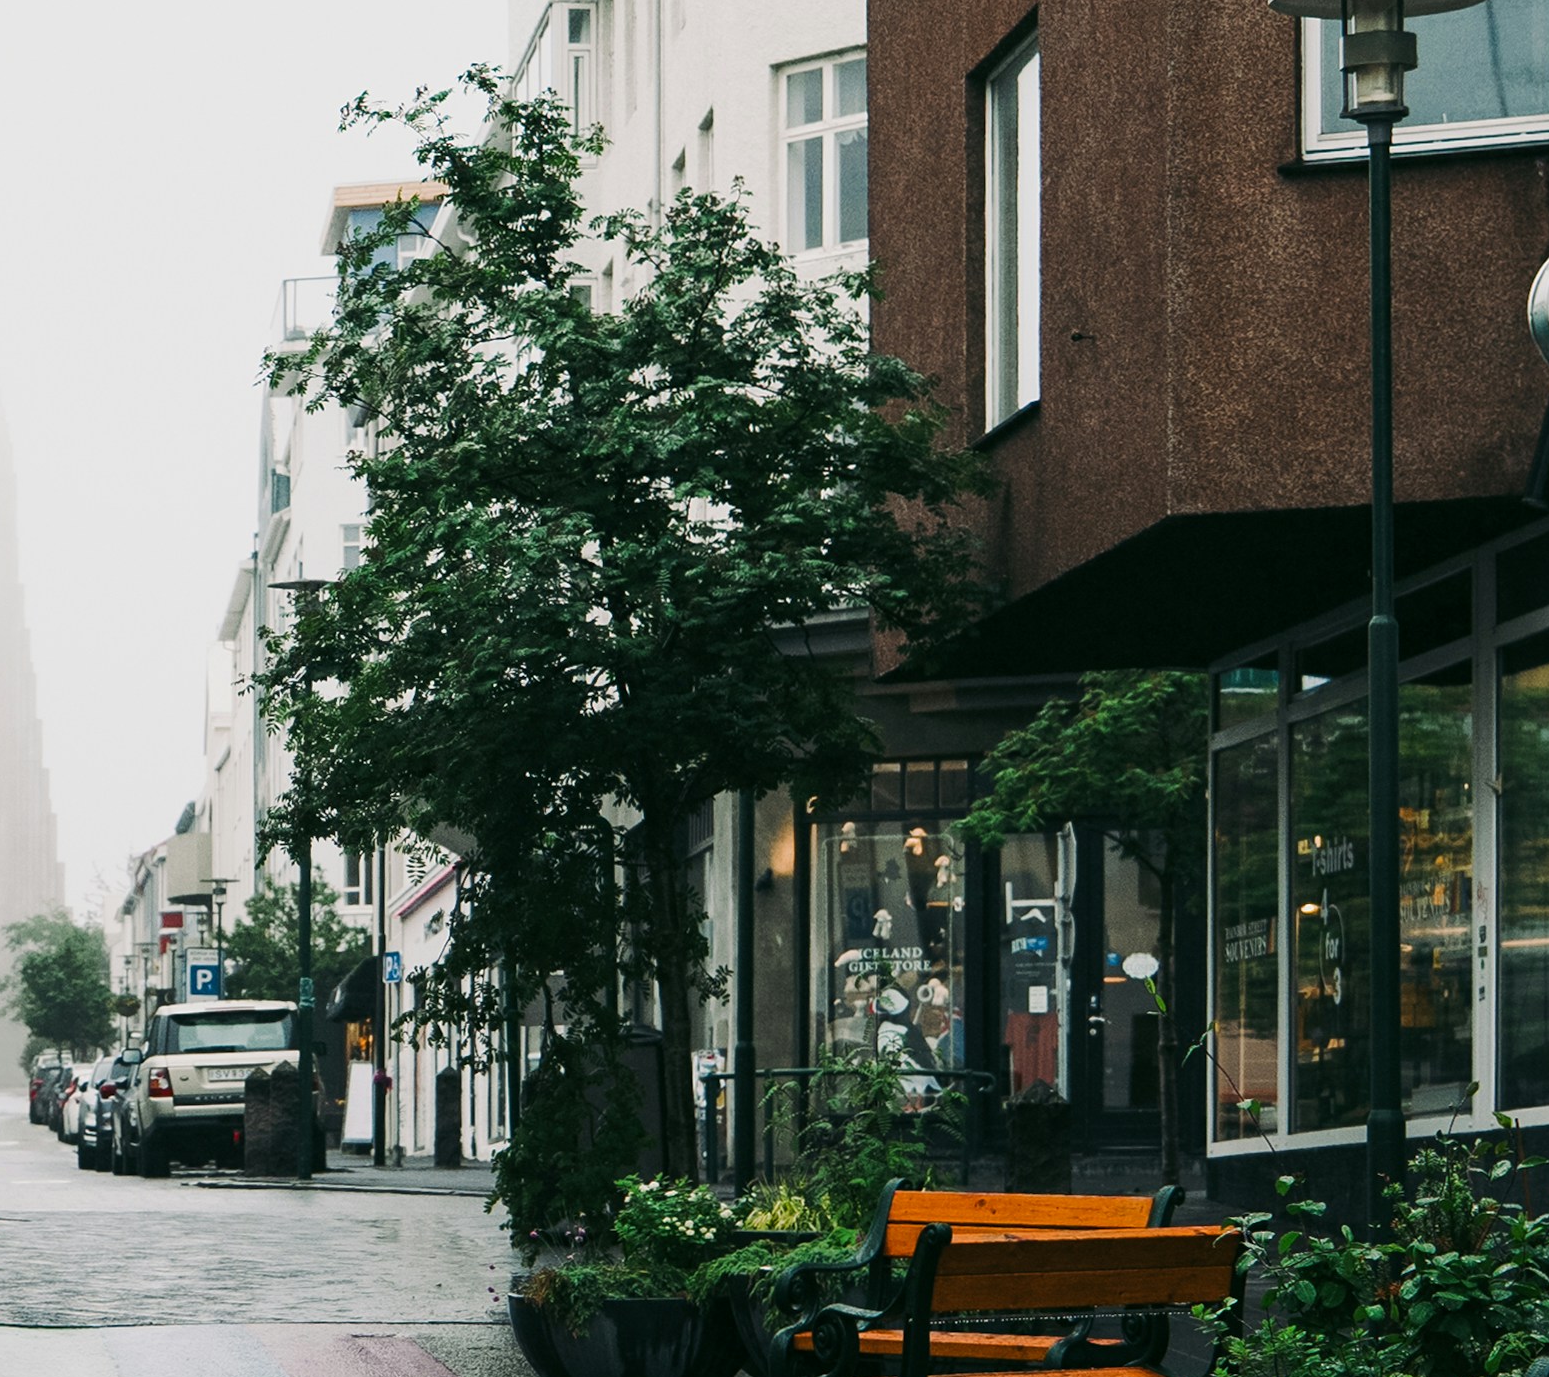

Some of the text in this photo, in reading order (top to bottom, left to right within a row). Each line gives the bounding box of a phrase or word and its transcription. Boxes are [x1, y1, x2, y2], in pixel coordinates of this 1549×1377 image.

[1311, 837, 1354, 877] T-shirts
[859, 946, 923, 960] ICELAND
[1224, 936, 1267, 963] SOUVENIRS
[1325, 932, 1340, 960] for
[891, 960, 932, 972] TORE
